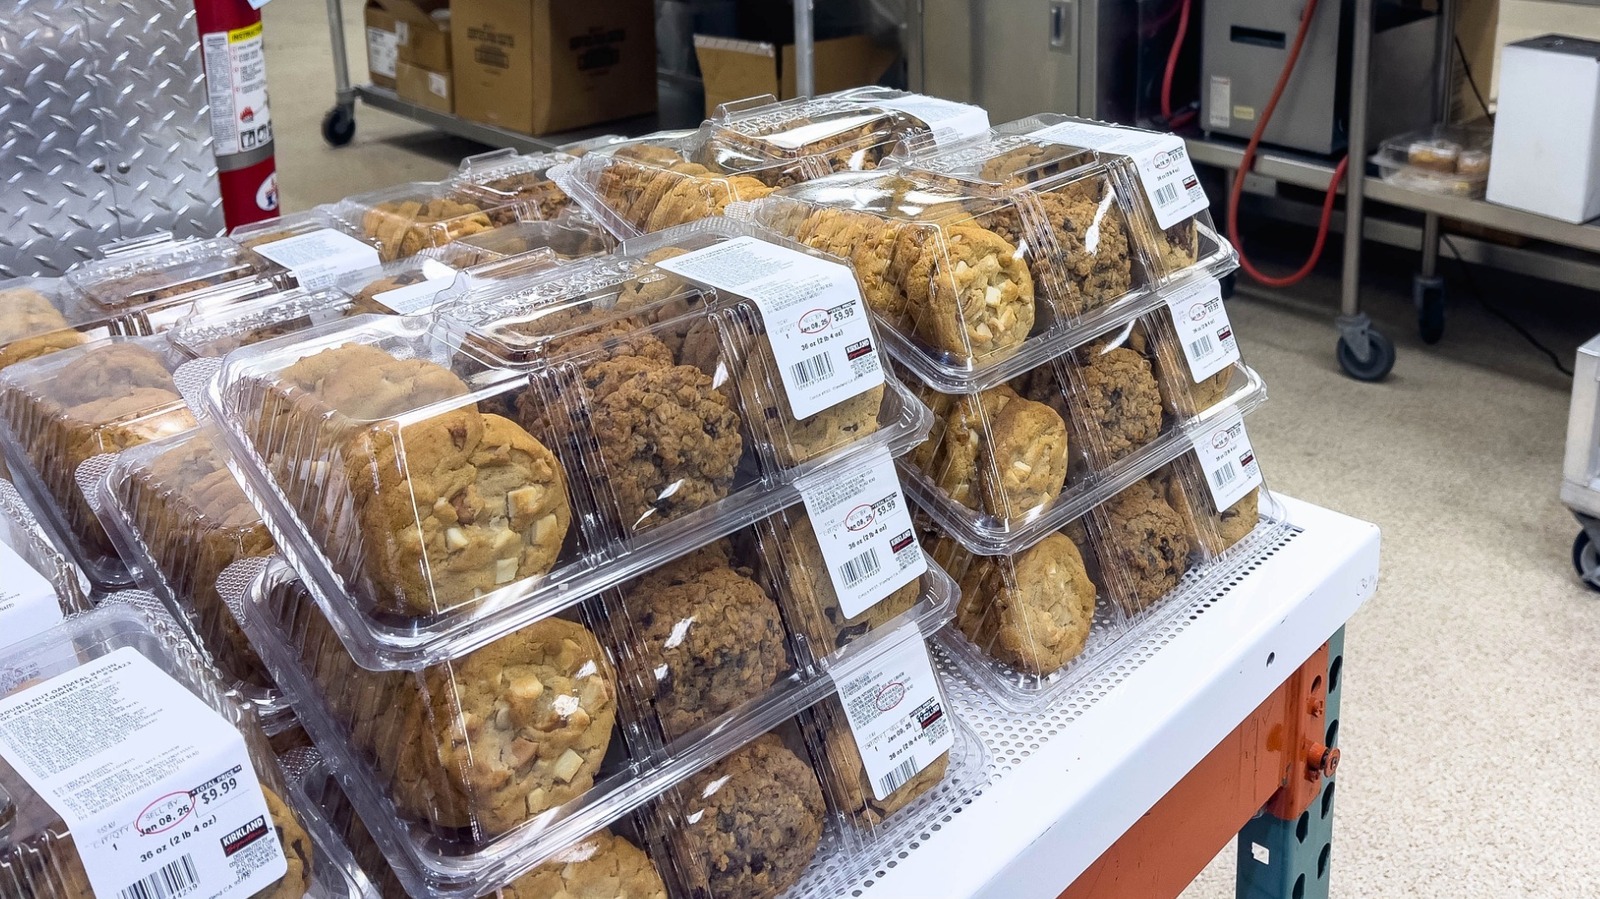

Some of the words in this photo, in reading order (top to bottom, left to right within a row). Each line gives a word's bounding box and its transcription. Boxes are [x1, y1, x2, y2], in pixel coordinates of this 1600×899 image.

[834, 308, 854, 322] $9.99
[877, 500, 896, 516] $9.99
[14, 701, 42, 716] CHUNK
[44, 685, 78, 702] COOKIES
[32, 692, 48, 703] NUT
[51, 675, 90, 694] OATMEAL
[201, 778, 237, 804] $9.99
[140, 823, 157, 837] Jan
[158, 814, 176, 826] 08,
[177, 805, 190, 817] 25
[145, 808, 164, 821] SELL
[167, 800, 178, 810] BY
[140, 851, 154, 863] 36
[156, 845, 167, 855] oz
[169, 836, 180, 847] (2
[182, 830, 191, 840] lb
[202, 814, 217, 828] oz)
[222, 817, 264, 847] KIRKLAND
[112, 843, 118, 851] 1
